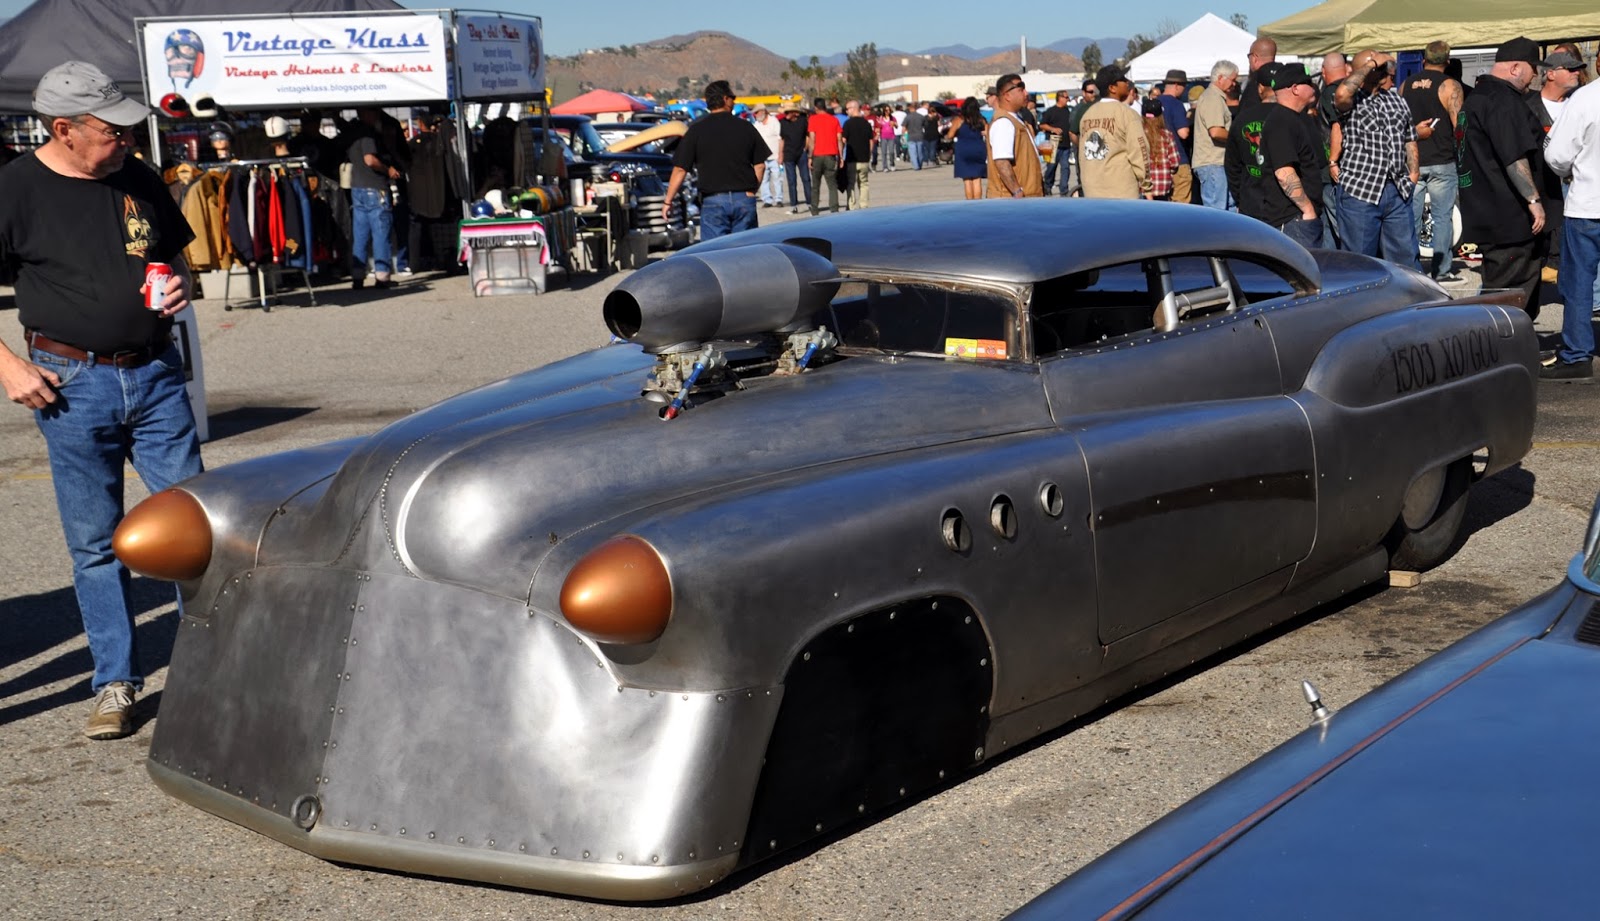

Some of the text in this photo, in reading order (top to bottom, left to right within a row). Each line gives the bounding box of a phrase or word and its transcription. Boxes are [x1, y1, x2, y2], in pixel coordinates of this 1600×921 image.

[222, 27, 430, 57] Vintage Klass
[225, 62, 433, 80] Vintage Helmets & Leathers
[276, 83, 387, 94] vintageklass.blogspot.com
[125, 239, 149, 251] SPEED
[1391, 342, 1437, 394] 1503
